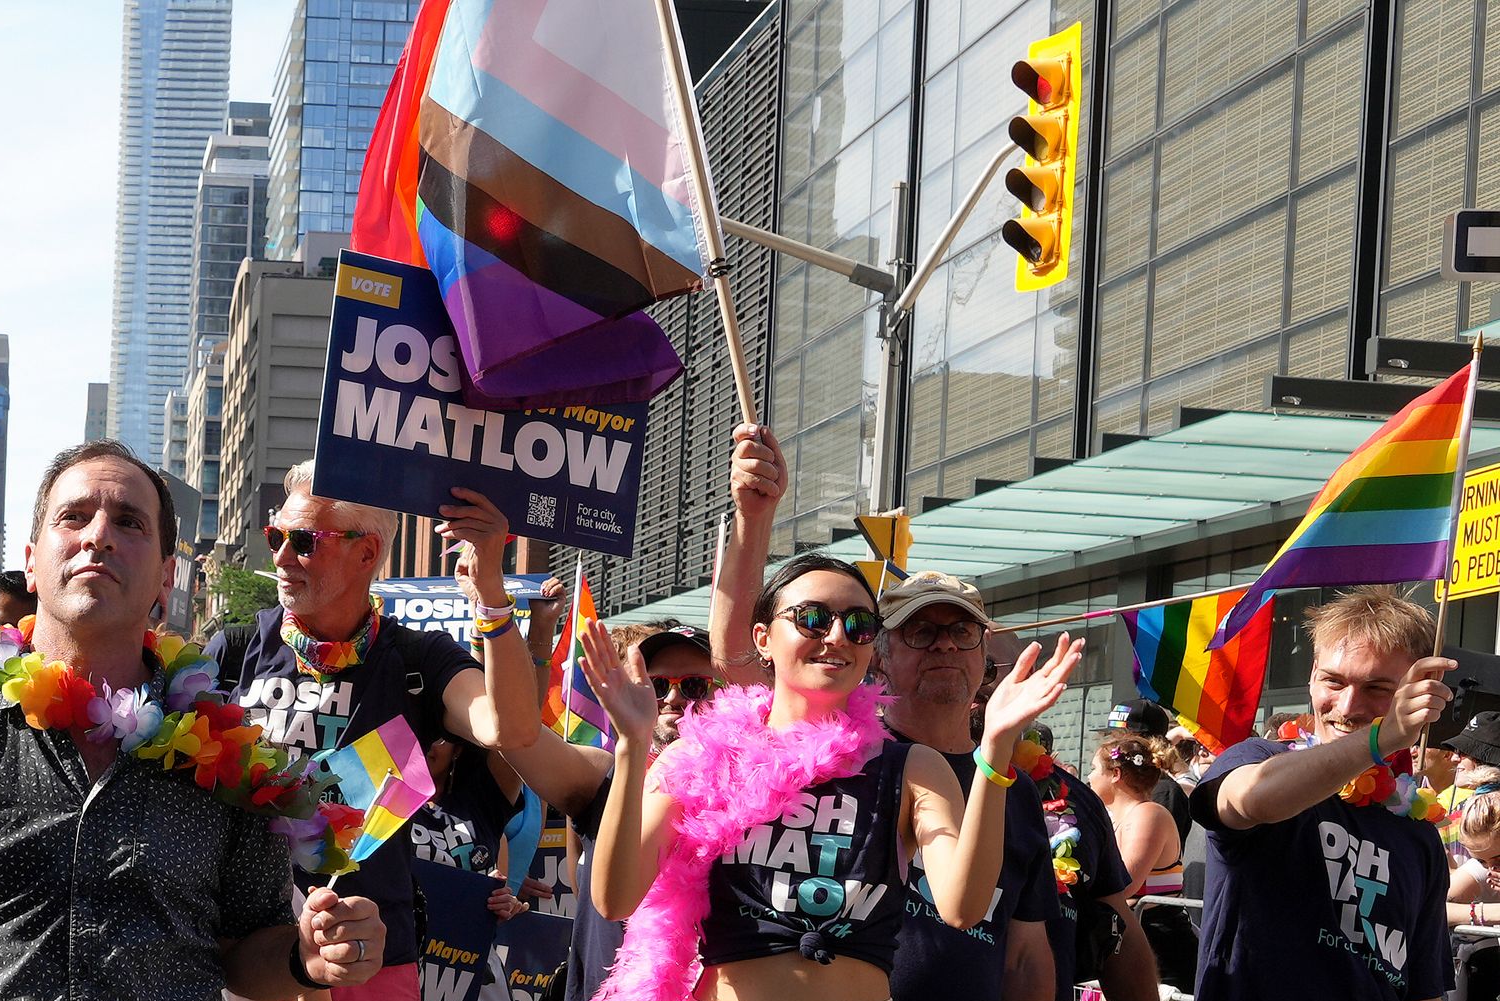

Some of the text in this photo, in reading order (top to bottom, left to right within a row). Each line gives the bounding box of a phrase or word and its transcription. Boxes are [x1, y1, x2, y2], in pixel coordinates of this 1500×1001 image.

[351, 275, 392, 297] VOTE
[340, 316, 461, 393] JOS
[563, 405, 636, 432] Mayor
[333, 379, 632, 494] MATLOW
[576, 515, 623, 535] that works.
[577, 503, 616, 523] For a city
[1463, 515, 1500, 548] MUST
[389, 598, 474, 621] JOSH
[240, 677, 353, 716] JOSH
[541, 833, 563, 843] OTE
[721, 825, 852, 876] MAT
[1318, 821, 1390, 884] OSH
[771, 870, 888, 921] LOW
[425, 938, 480, 965] Mayor
[1318, 928, 1343, 948] For
[509, 968, 533, 986] for
